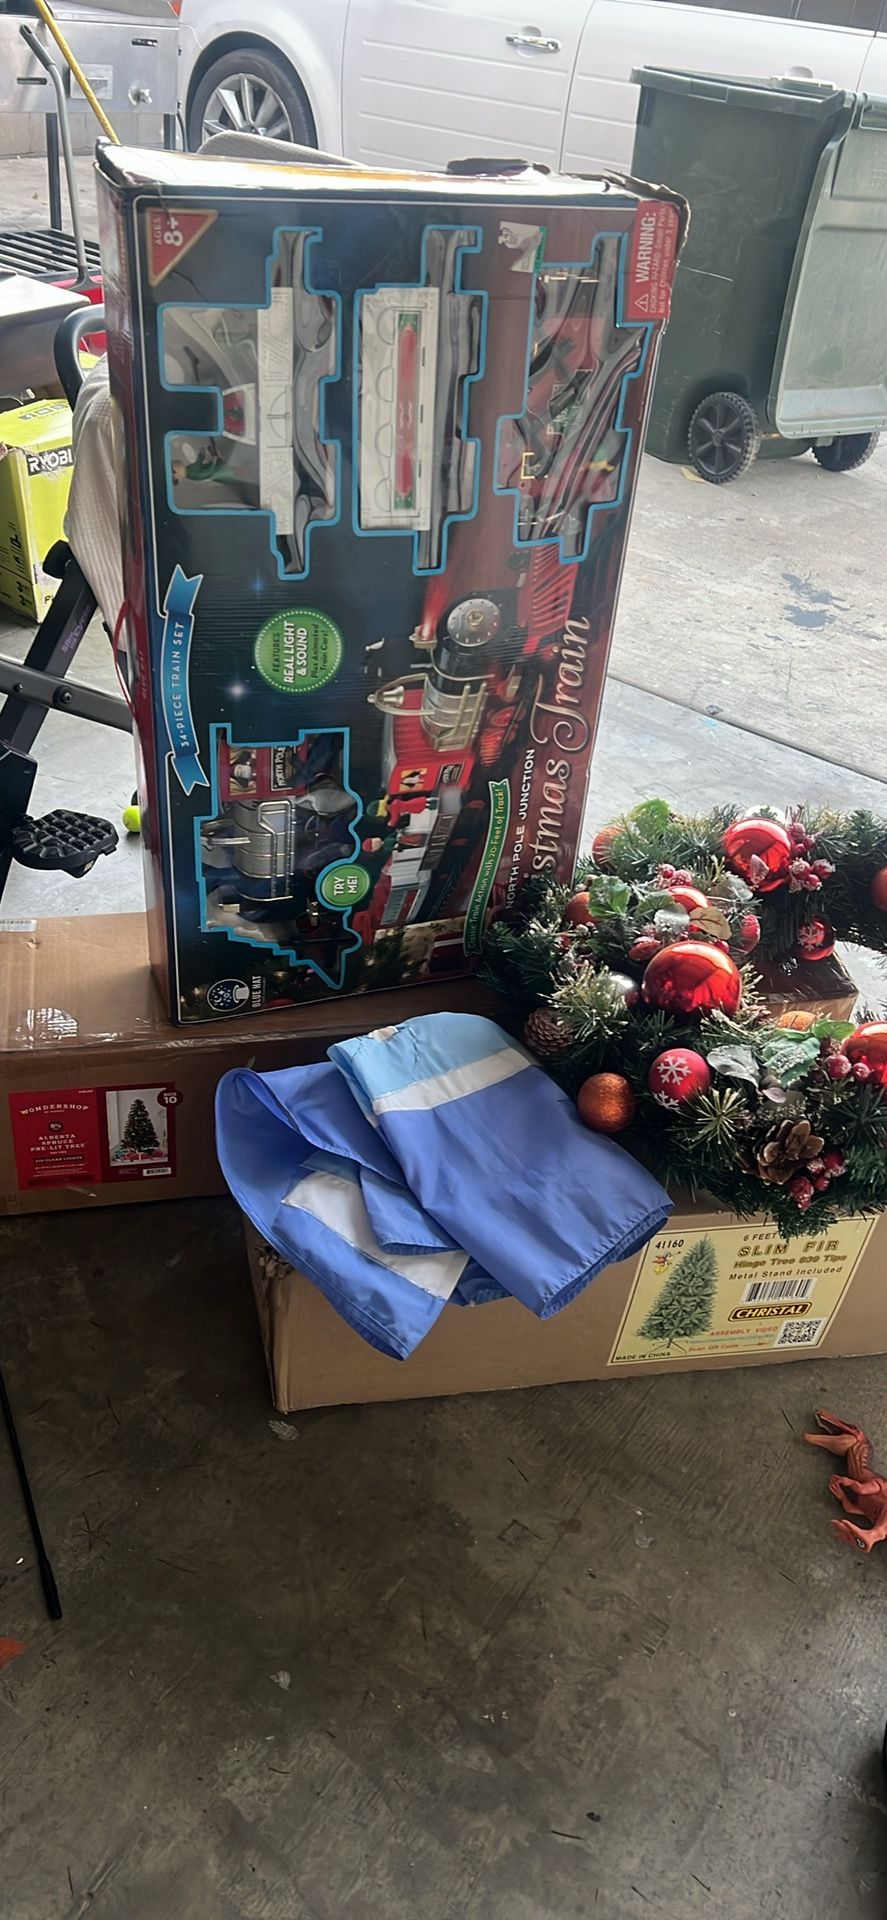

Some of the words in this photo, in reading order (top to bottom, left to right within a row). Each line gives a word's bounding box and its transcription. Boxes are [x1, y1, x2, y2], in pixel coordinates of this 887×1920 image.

[153, 217, 162, 246] AGES
[163, 216, 183, 247] 8+
[634, 212, 656, 283] WARNING:
[28, 448, 73, 472] RYOBI
[172, 622, 184, 646] SET
[284, 620, 294, 654] LIGHT
[296, 628, 308, 666] SOUND
[172, 651, 180, 688] TRAIN
[284, 656, 294, 683] REAL
[296, 668, 307, 676] &
[530, 616, 592, 753] Train
[172, 692, 190, 747] 34-PIECE
[518, 749, 536, 820] JUNCTION
[494, 788, 505, 814] Track!
[494, 816, 506, 824] of
[513, 825, 526, 862] POLE
[484, 860, 494, 876] with
[334, 876, 344, 896] TRY
[347, 876, 358, 894] ME!
[475, 878, 488, 904] Action
[506, 866, 520, 910] NORTH
[470, 904, 480, 923] Train
[252, 976, 262, 989] HAT
[252, 990, 262, 1008] BLUE
[20, 1104, 88, 1115] WONDERSHOP
[655, 1239, 684, 1249] 41160
[738, 1243, 789, 1257] SLIM
[802, 1240, 840, 1253] FIR
[752, 1232, 778, 1241] FEET
[733, 1260, 766, 1268] Hinge
[761, 1269, 792, 1278] Stand
[796, 1266, 843, 1275] Included
[736, 1305, 804, 1318] CHRISTAL
